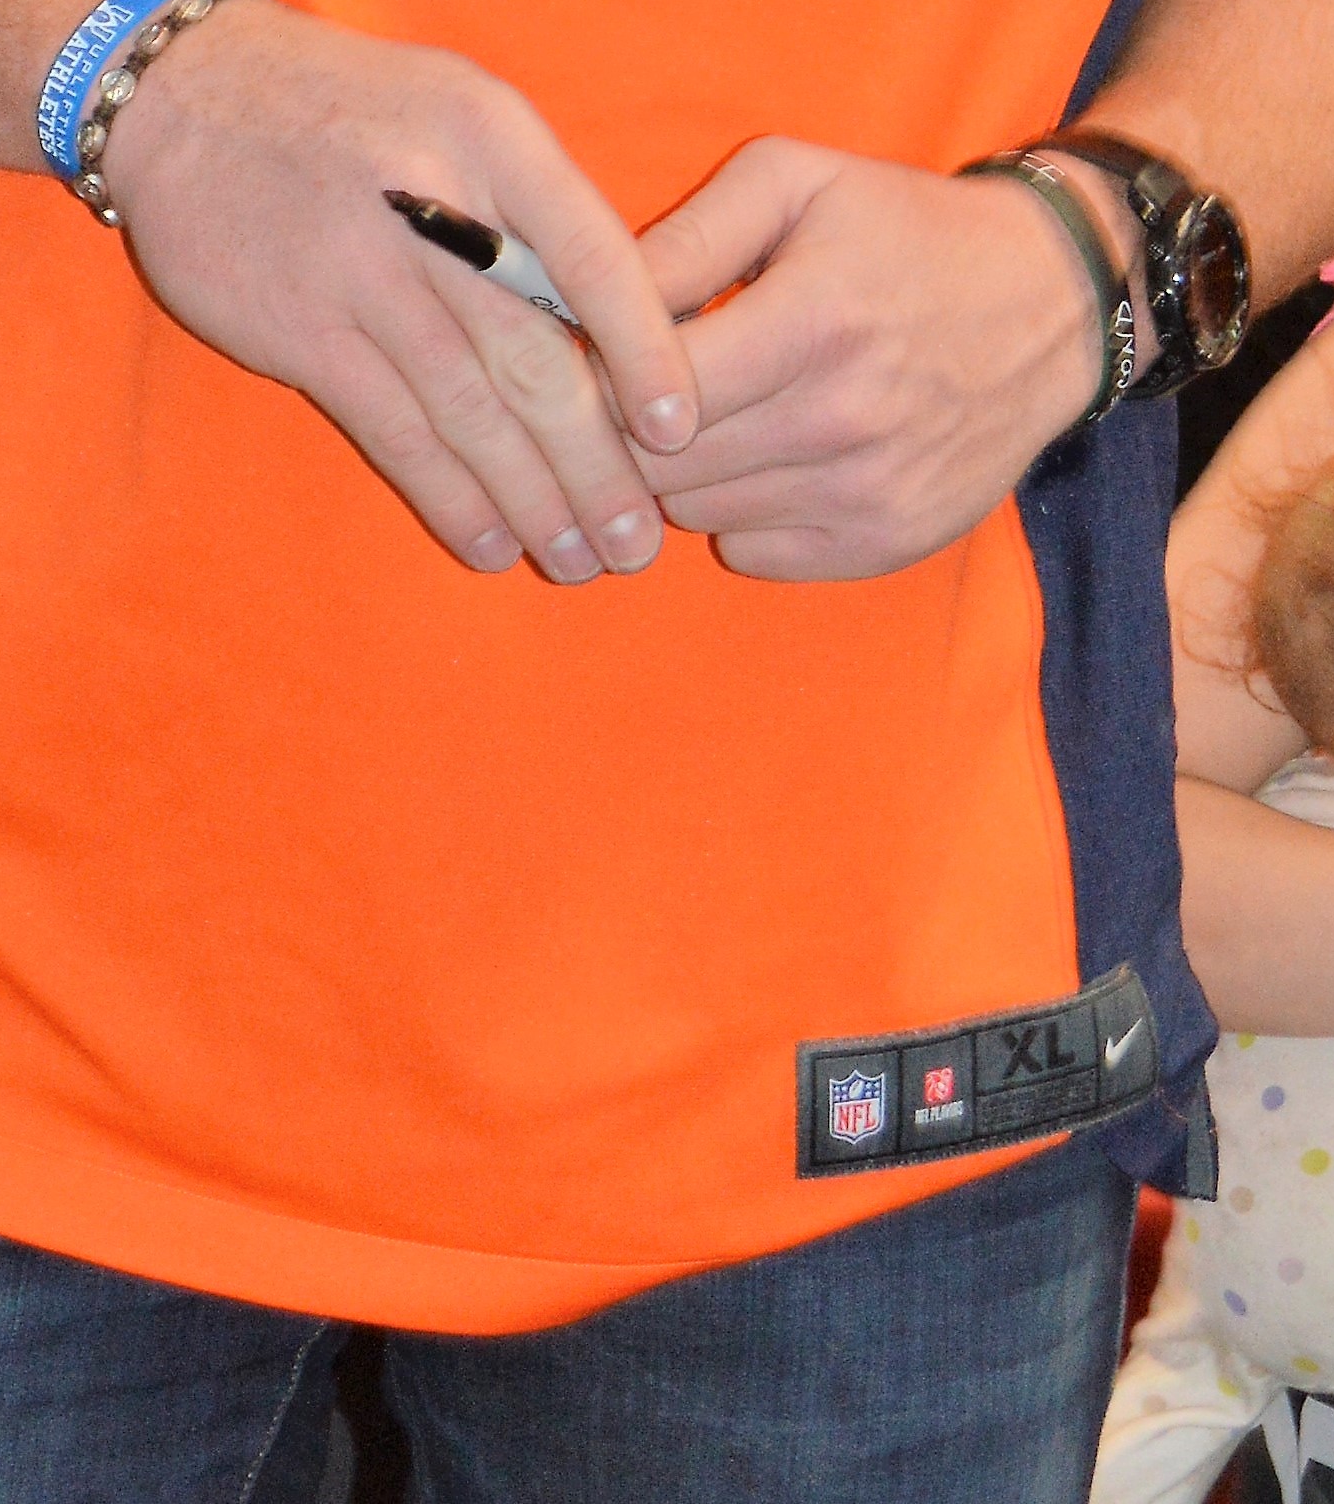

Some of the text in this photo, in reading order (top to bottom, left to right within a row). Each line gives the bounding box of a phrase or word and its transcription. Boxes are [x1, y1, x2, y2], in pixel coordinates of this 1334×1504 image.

[38, 32, 89, 157] ATHLETES
[1002, 1022, 1076, 1080] XL
[836, 1103, 877, 1135] NFL
